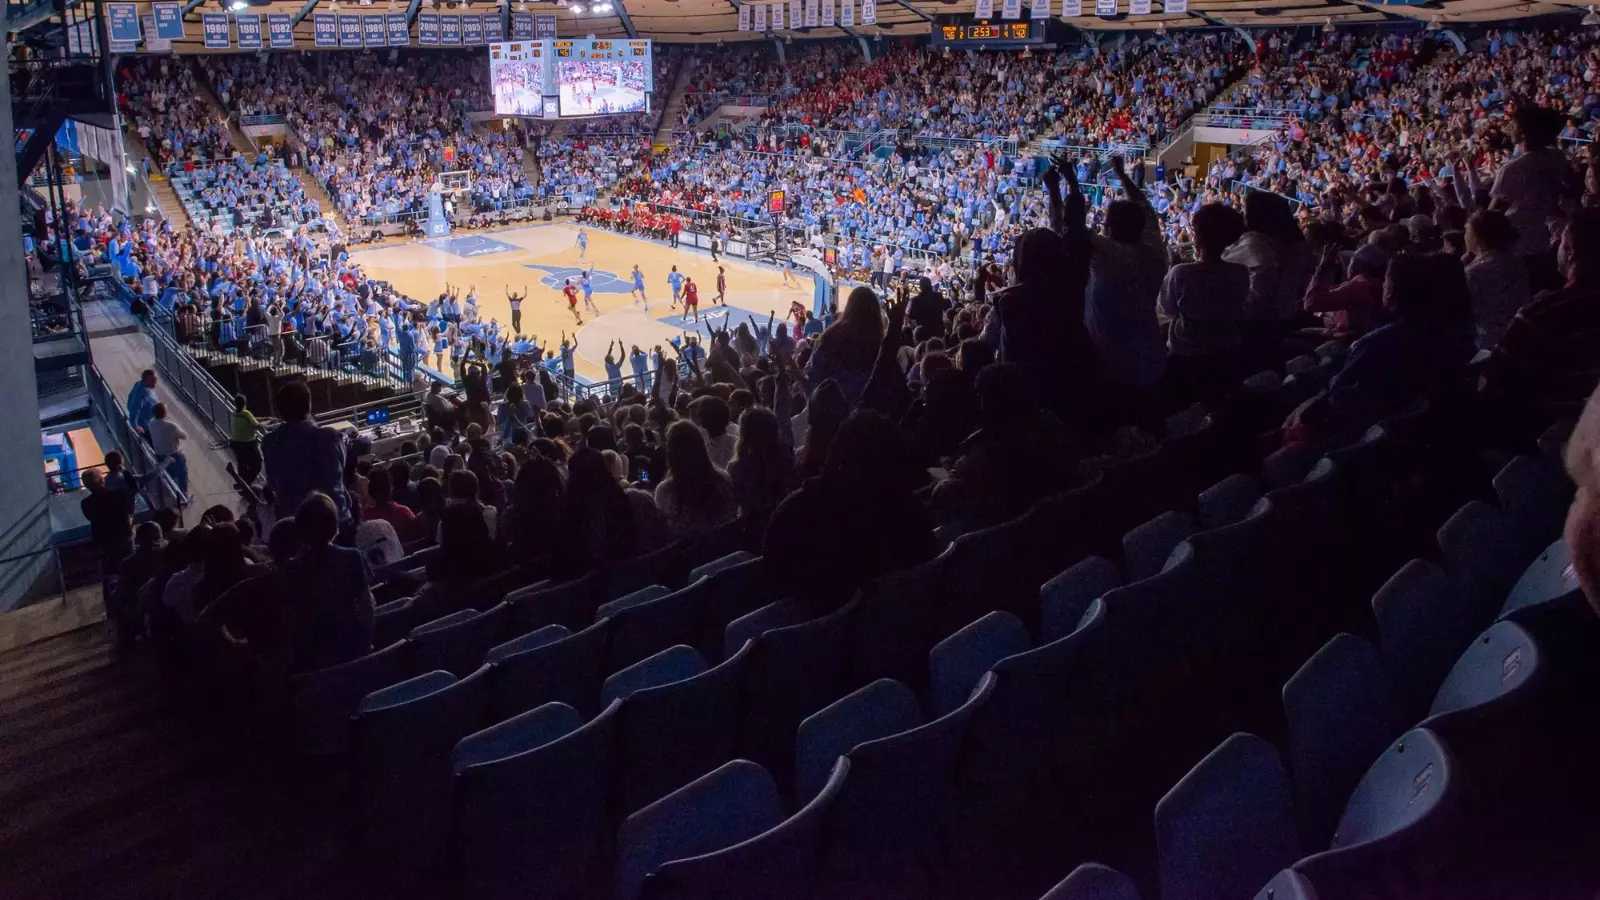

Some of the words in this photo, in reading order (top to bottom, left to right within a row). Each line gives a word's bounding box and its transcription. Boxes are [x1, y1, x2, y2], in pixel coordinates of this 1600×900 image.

[206, 24, 228, 33] 1980
[239, 24, 259, 33] 1981
[270, 24, 291, 33] 1982
[317, 23, 335, 32] 1983
[341, 24, 360, 33] 1988
[365, 24, 383, 33] 1989
[389, 22, 407, 31] 1999
[420, 22, 438, 31] 2000
[442, 23, 459, 32] 2001
[515, 23, 531, 31] 2014
